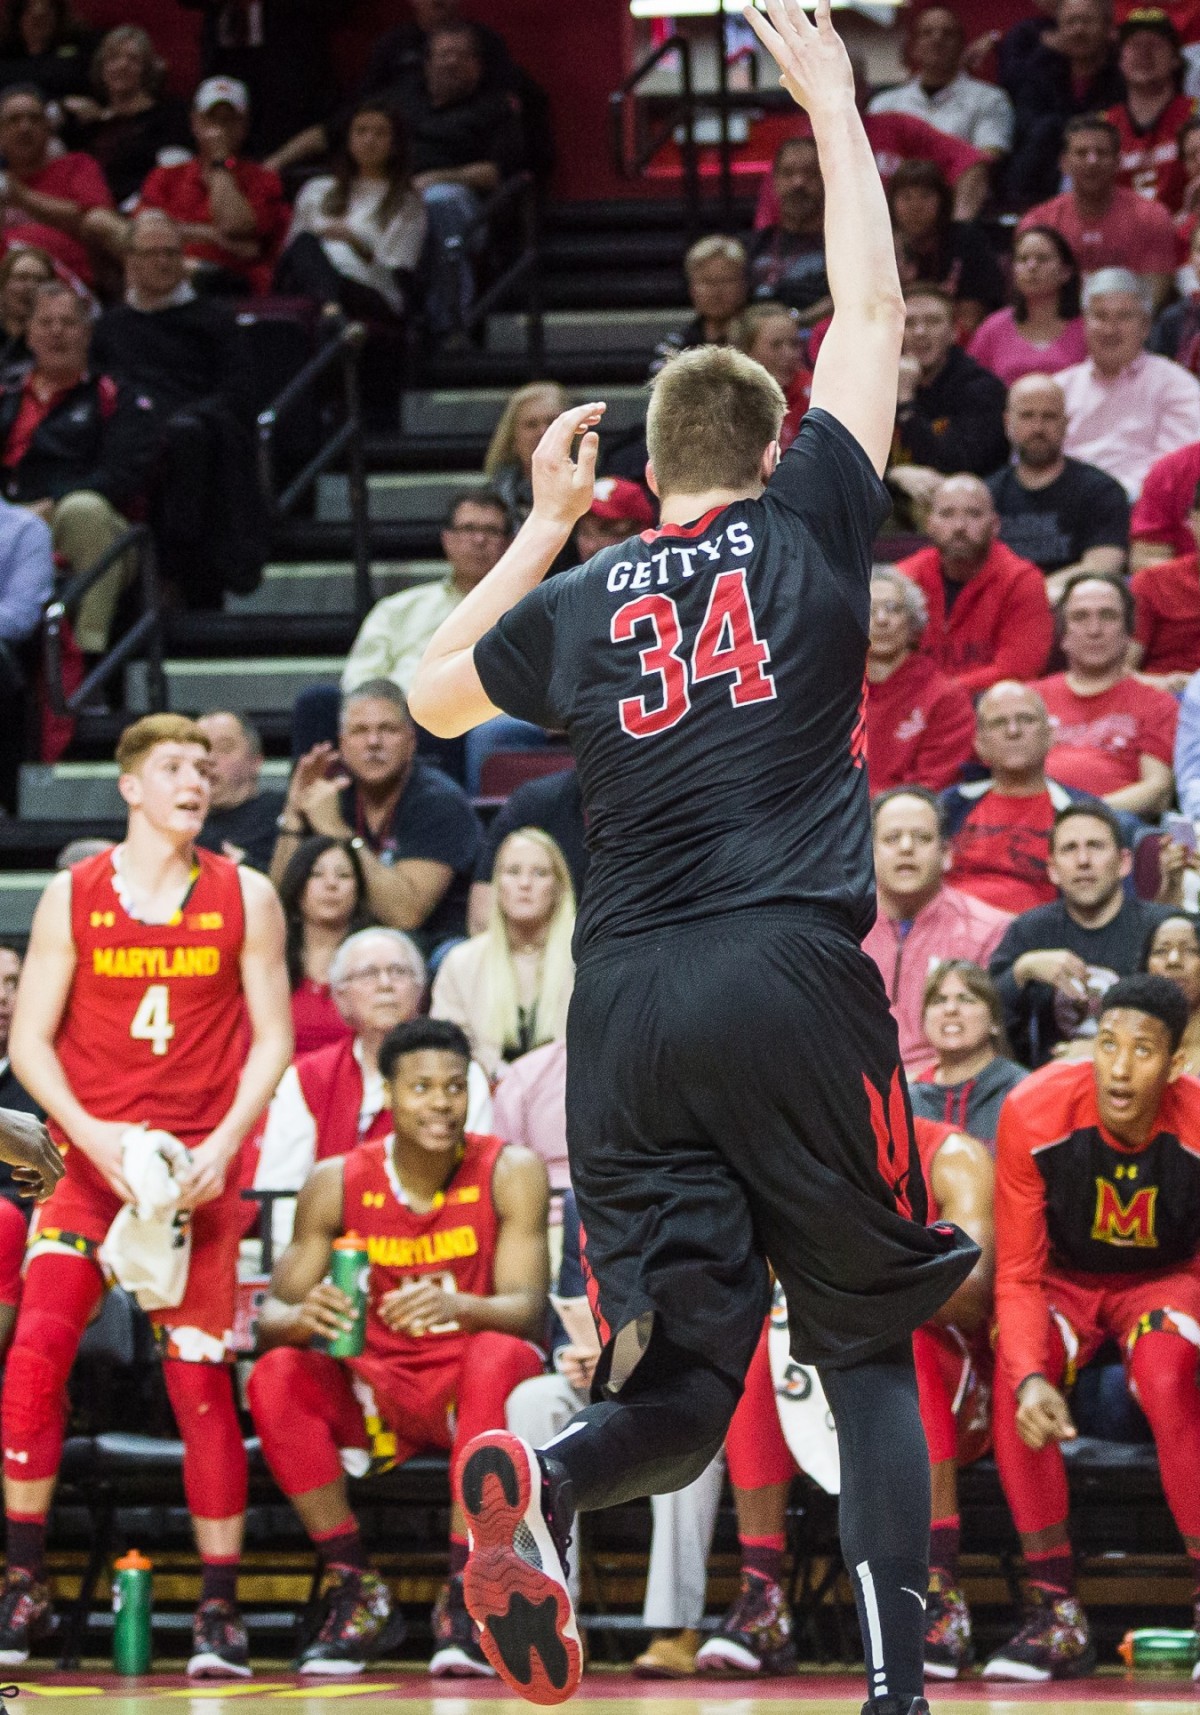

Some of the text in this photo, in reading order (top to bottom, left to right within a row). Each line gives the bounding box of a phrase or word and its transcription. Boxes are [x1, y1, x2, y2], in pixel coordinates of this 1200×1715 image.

[606, 521, 755, 592] GETTYS
[610, 567, 778, 739] 34
[92, 945, 220, 978] MARYLAND
[130, 982, 175, 1056] 4
[367, 1224, 479, 1267] MARYLAND
[1091, 1176, 1159, 1247] M
